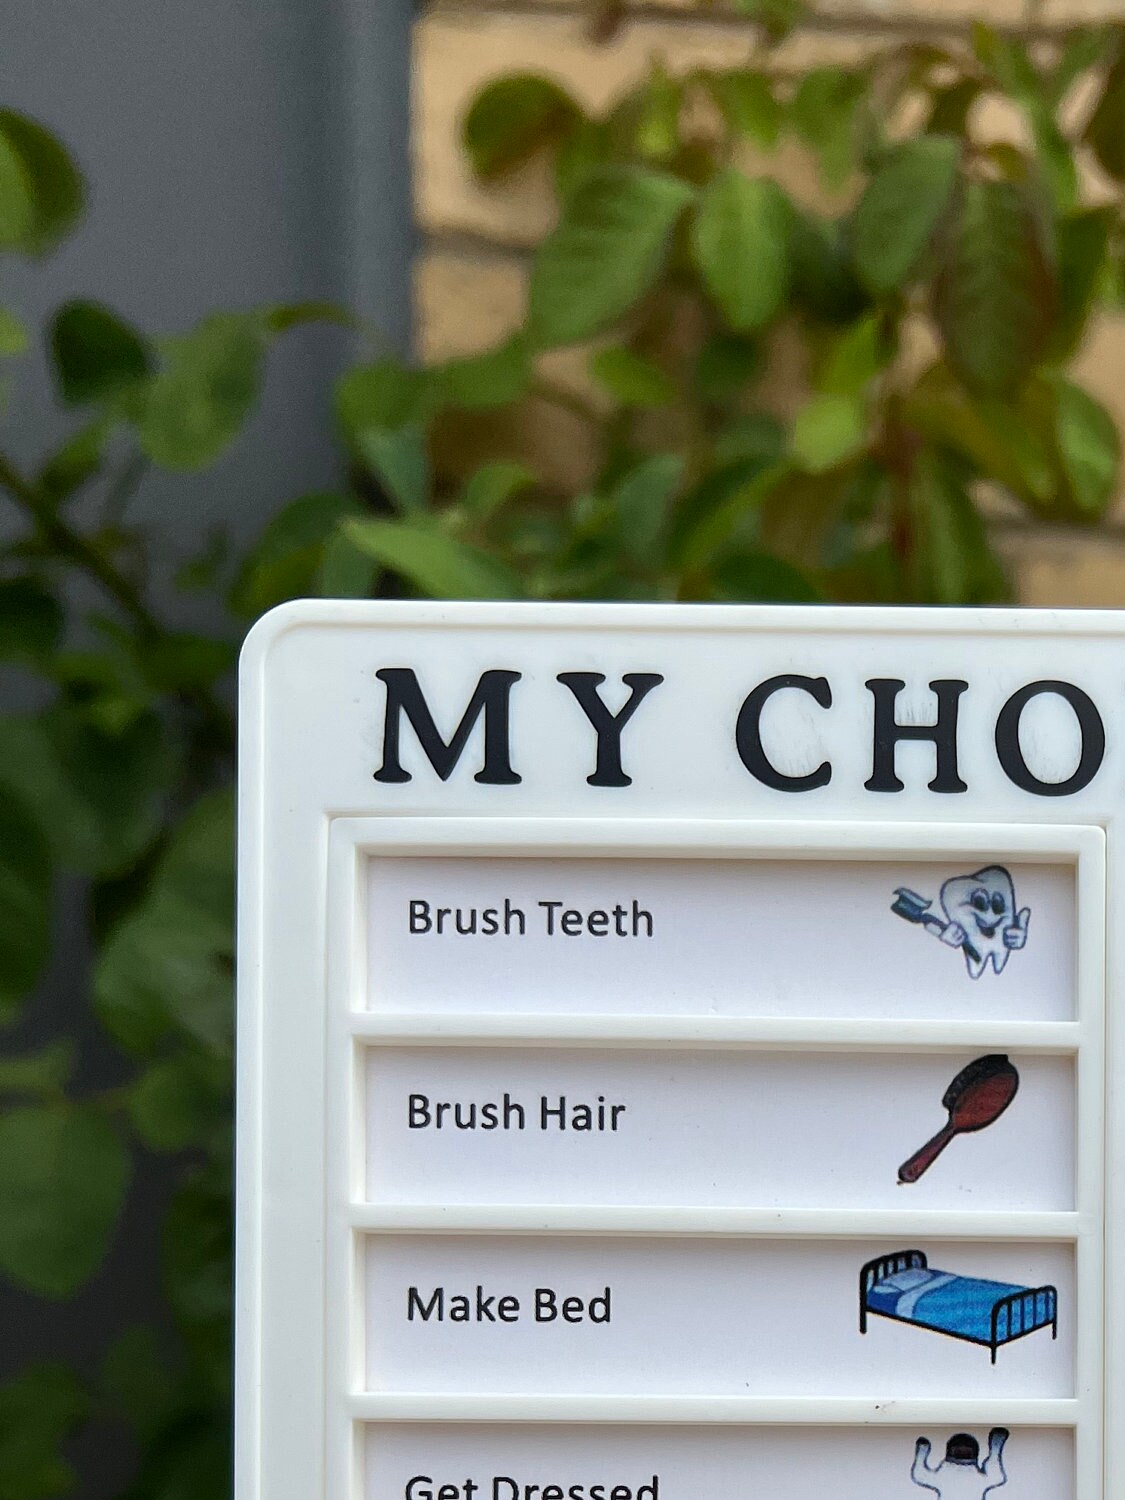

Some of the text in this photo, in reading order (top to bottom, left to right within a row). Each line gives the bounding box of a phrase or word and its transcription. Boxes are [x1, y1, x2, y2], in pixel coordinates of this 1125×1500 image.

[372, 667, 665, 788] MY
[409, 898, 653, 938] Brush Teeth
[408, 1092, 626, 1132] Brush Hair
[407, 1284, 611, 1324] Make Bed
